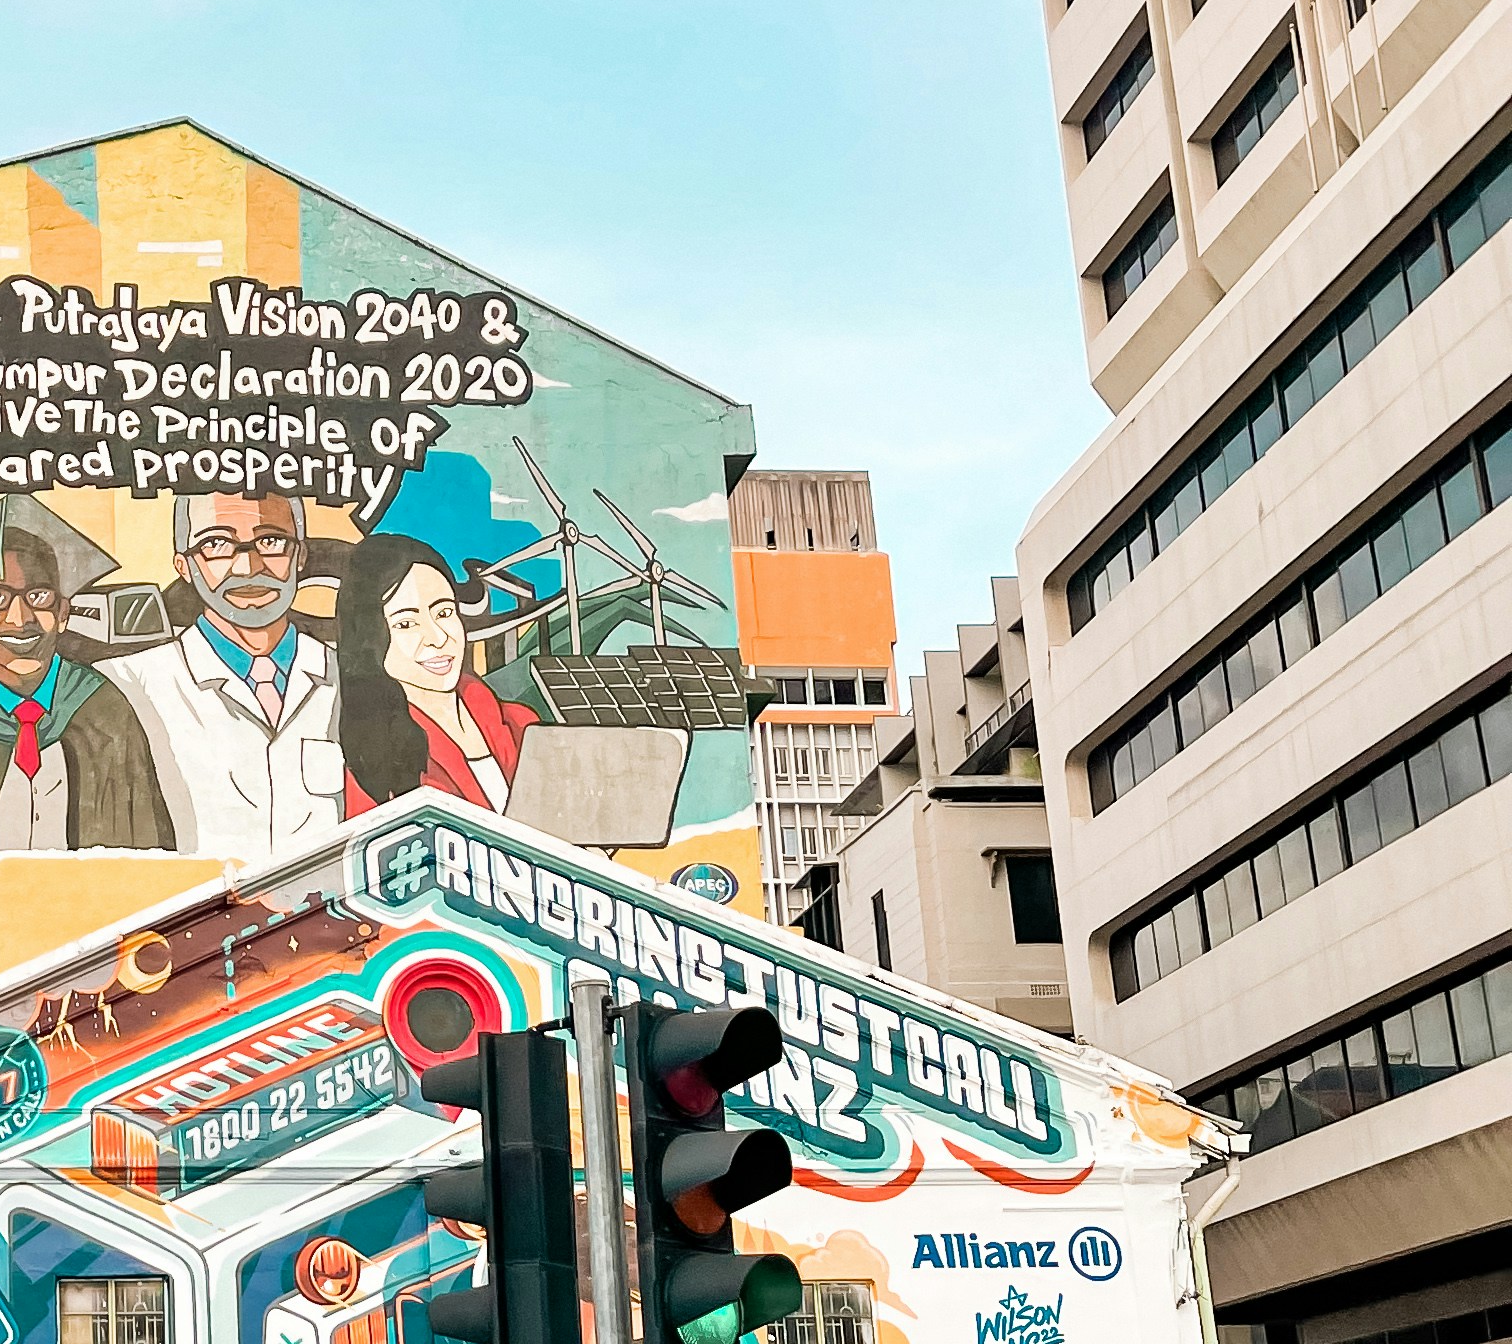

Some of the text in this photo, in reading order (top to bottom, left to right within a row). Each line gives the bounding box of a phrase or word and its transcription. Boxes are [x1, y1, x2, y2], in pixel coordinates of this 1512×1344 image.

[10, 279, 208, 353] Putrajaya
[216, 282, 346, 339] Vision
[355, 293, 461, 343] 2040
[481, 298, 520, 344] &
[114, 347, 390, 401] Declaration
[400, 352, 528, 403] 2020
[64, 399, 141, 441] The
[152, 404, 349, 453] Principle
[685, 878, 726, 893] APEC
[135, 1012, 365, 1117] HOTLINE
[12, 1090, 42, 1128] CALL
[185, 1046, 393, 1160] 1800 22 5542
[912, 1233, 1059, 1269] Allianz
